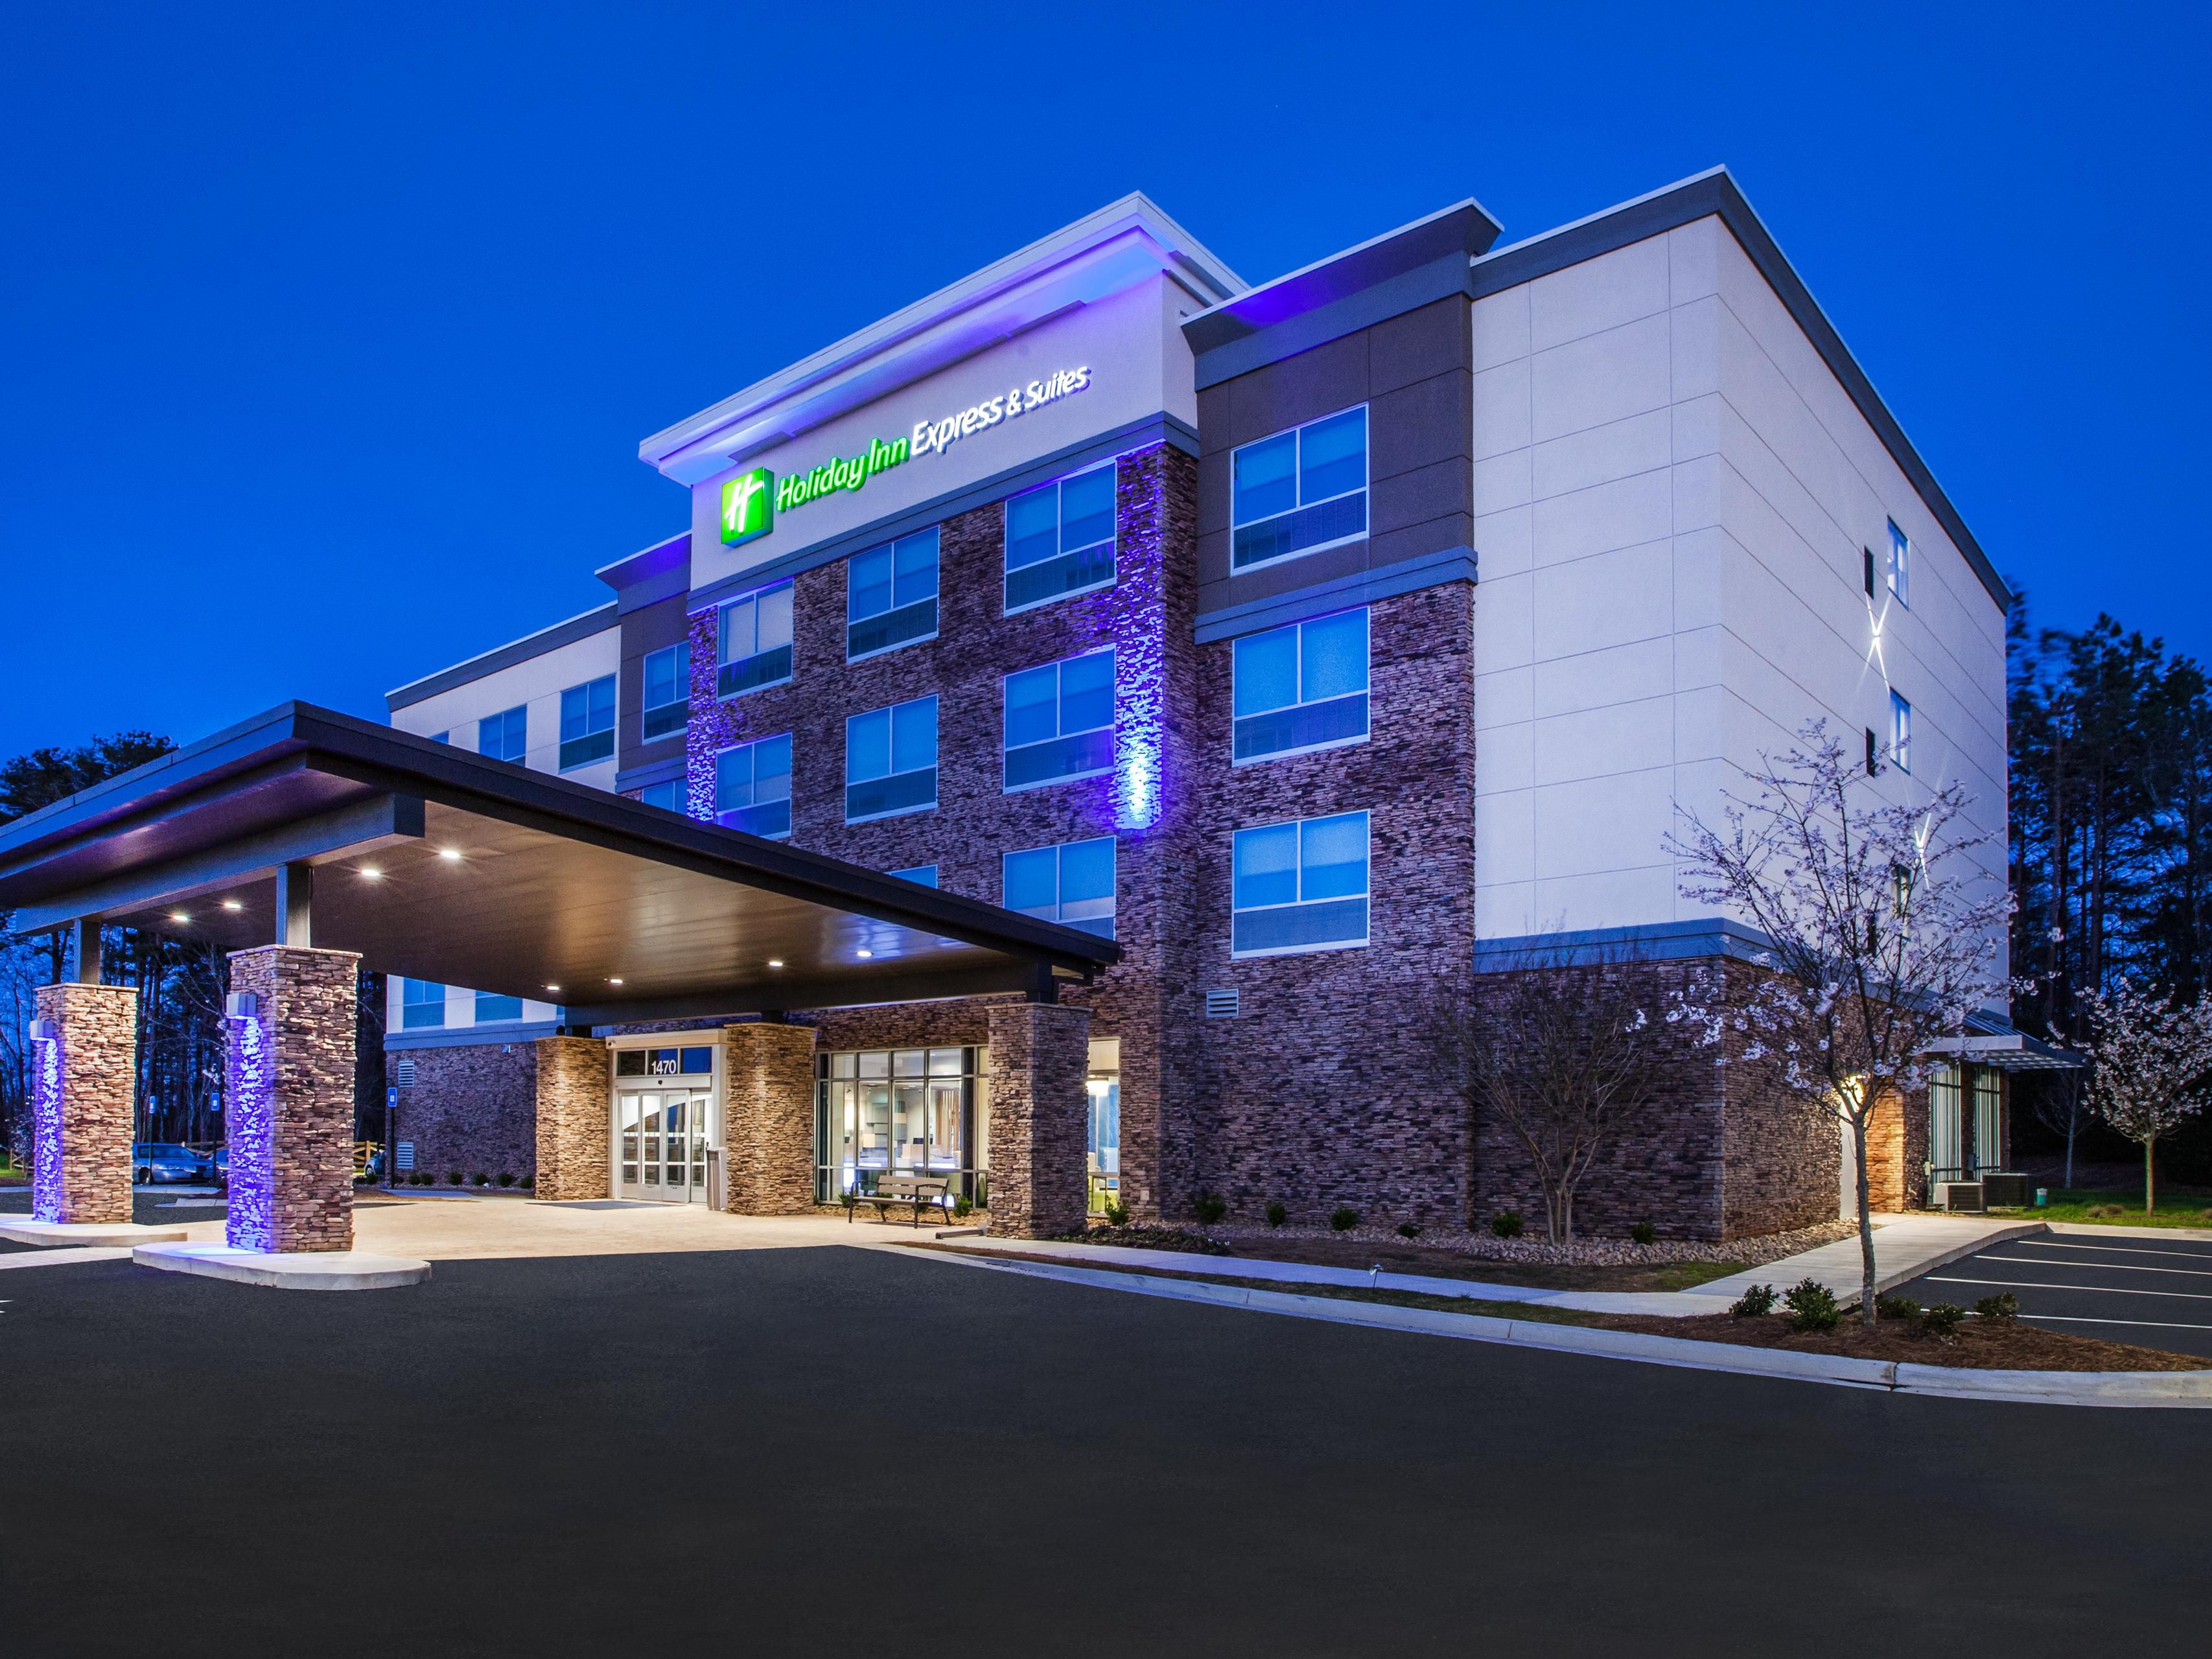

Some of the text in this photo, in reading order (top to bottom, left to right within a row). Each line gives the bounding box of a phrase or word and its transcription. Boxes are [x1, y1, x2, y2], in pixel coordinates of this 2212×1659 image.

[776, 366, 1091, 512] Holiday Inn Express & Suites
[651, 1060, 677, 1074] 1470
